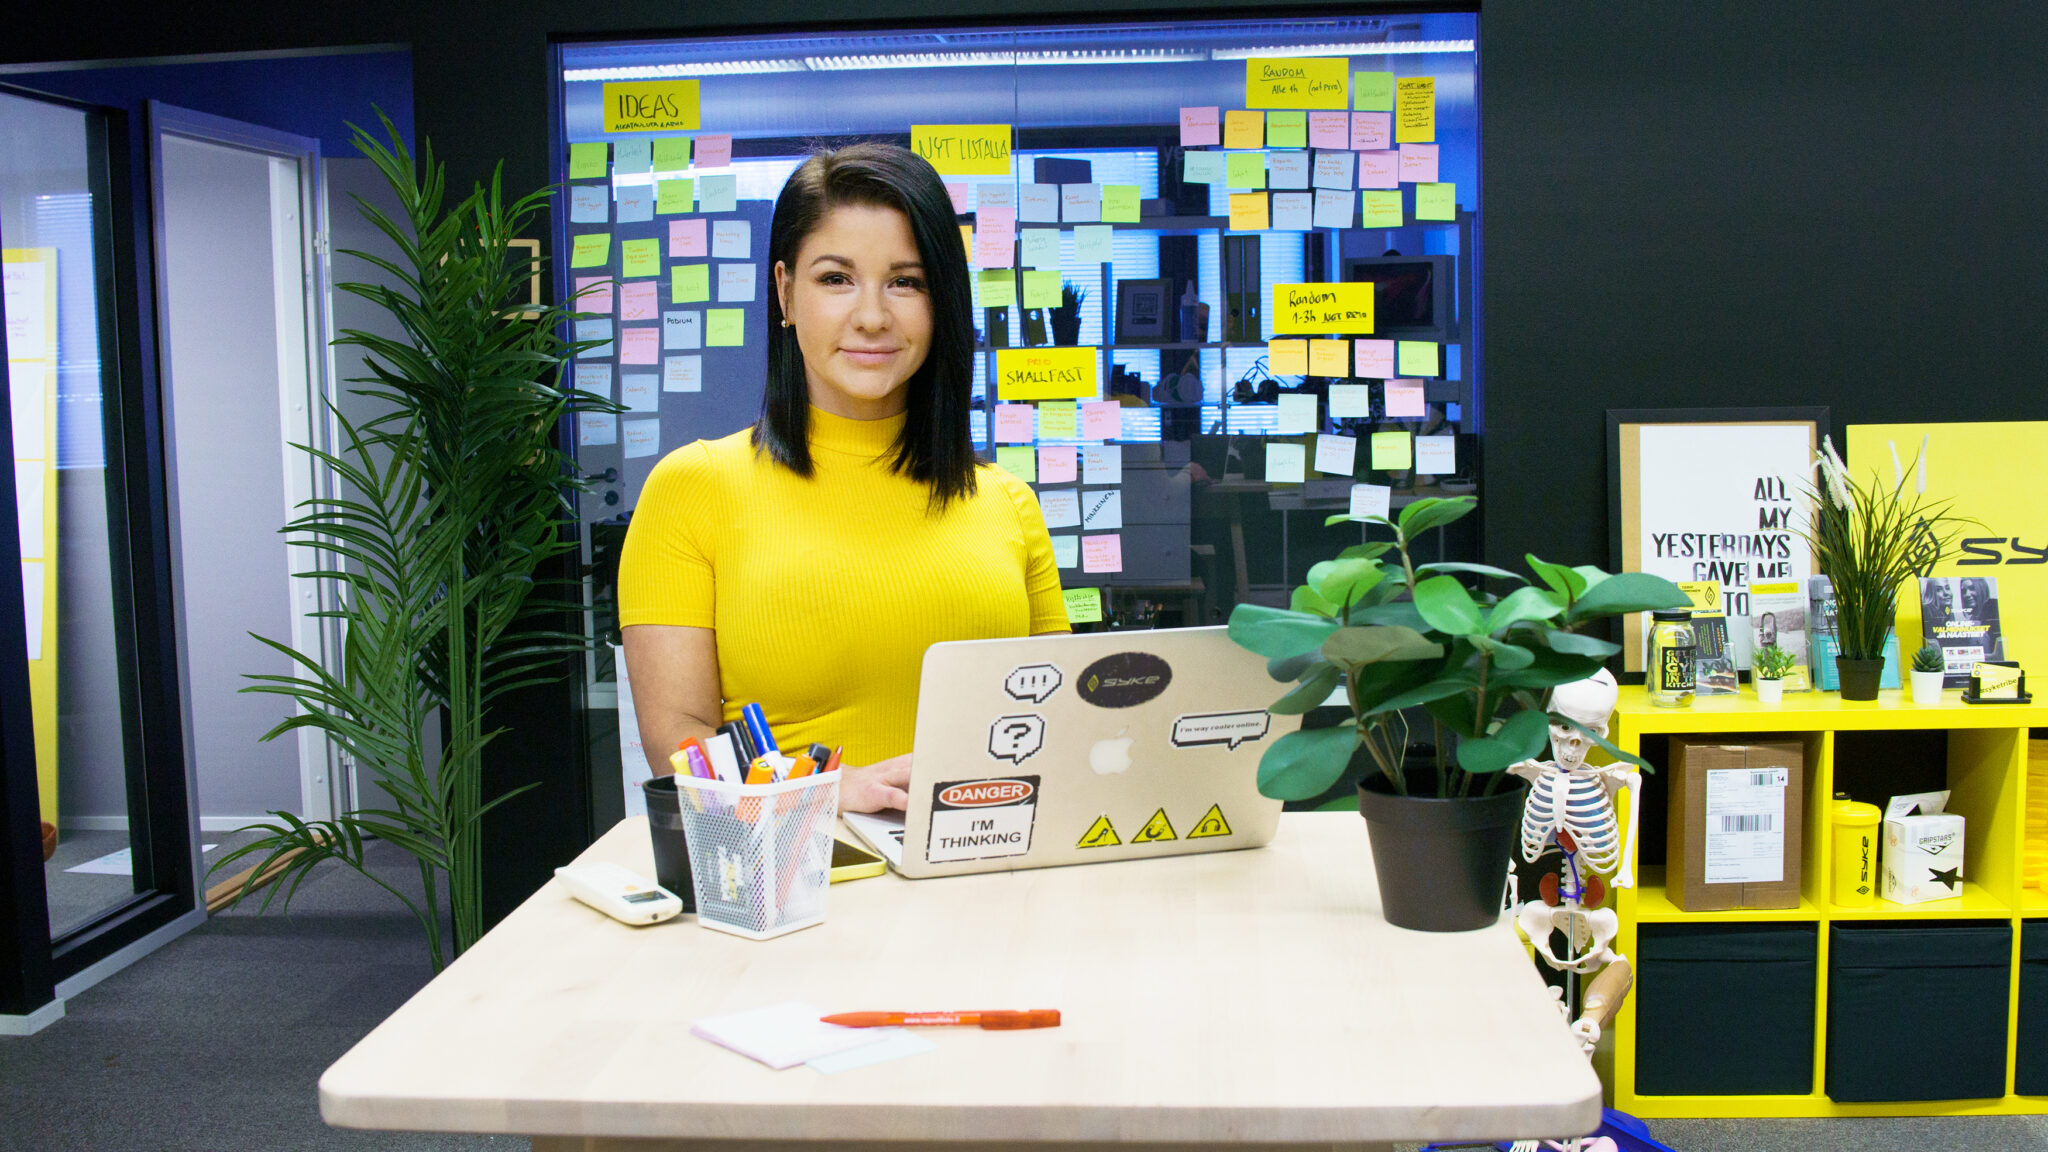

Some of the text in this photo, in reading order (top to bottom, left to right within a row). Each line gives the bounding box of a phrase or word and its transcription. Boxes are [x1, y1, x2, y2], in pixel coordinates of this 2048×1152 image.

[1263, 65, 1305, 78] RANDOM
[619, 93, 679, 119] IDEAS
[918, 136, 956, 160] NYT
[1289, 290, 1337, 307] Random
[666, 317, 693, 325] PODIUM
[1754, 476, 1791, 501] ALL
[1759, 507, 1792, 531] MY
[1652, 532, 1791, 559] YESTERDAYS
[1693, 561, 1790, 587] GAVE ME
[1102, 675, 1160, 687] SYKE
[949, 784, 1024, 802] DANGER
[971, 819, 994, 832] I'M
[939, 831, 1022, 849] THINKING
[1861, 836, 1869, 882] SYKE
